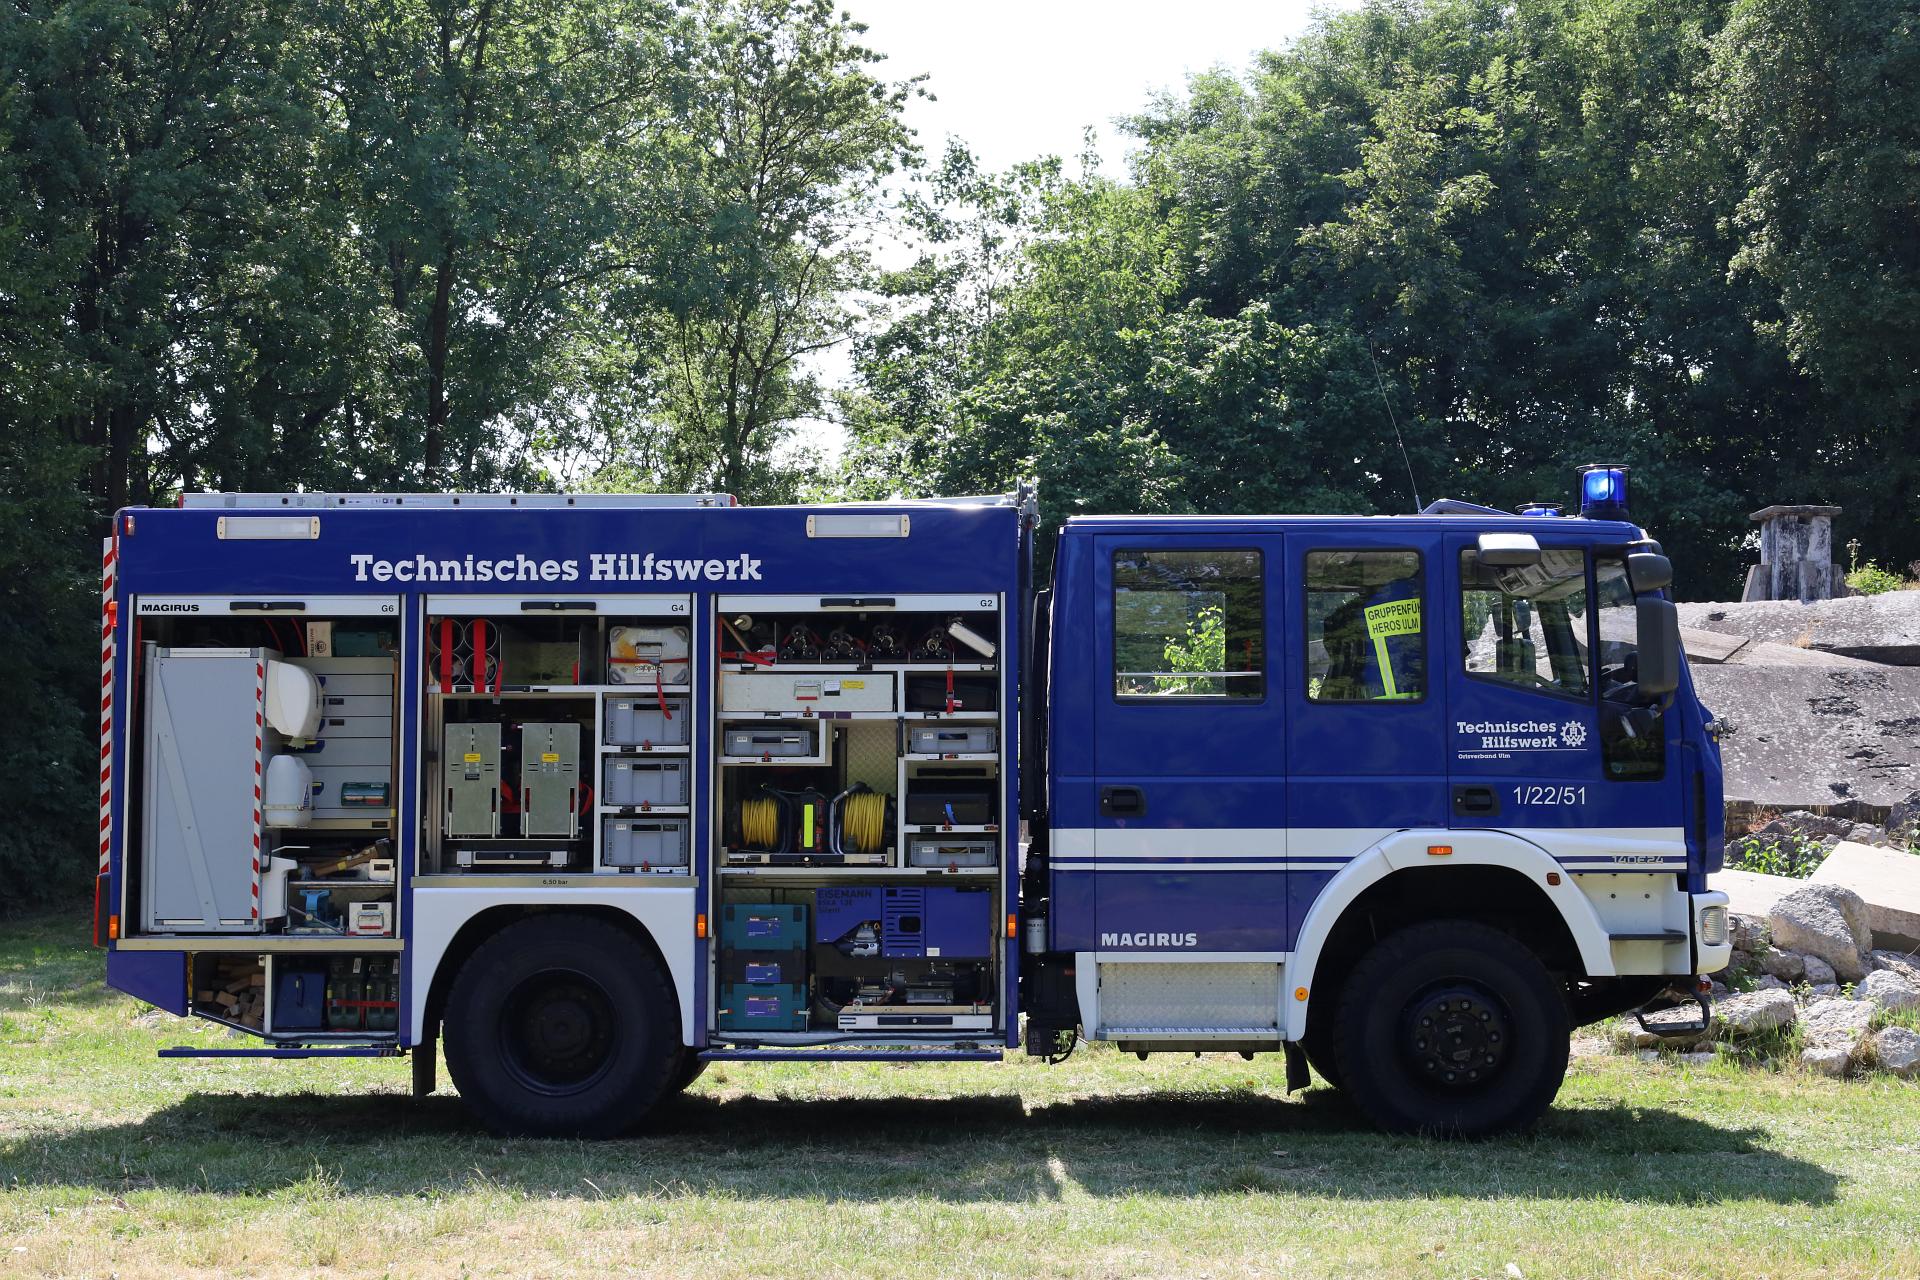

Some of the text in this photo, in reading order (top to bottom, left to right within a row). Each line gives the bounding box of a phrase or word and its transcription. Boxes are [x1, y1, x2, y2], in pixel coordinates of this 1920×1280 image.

[350, 553, 762, 582] Technisches Hilfswerk
[141, 603, 200, 612] MAGIRUS
[381, 604, 394, 613] G6
[671, 604, 684, 612] G4
[980, 599, 993, 607] G2
[1372, 617, 1418, 633] HEROS ULM
[1457, 720, 1557, 734] Technisches
[1482, 735, 1558, 748] Hilfswerk
[1513, 786, 1586, 805] 1/22/51
[1611, 855, 1664, 864] 140E24
[817, 888, 872, 898] EISEMANN
[1101, 932, 1198, 947] MAGIRUS
